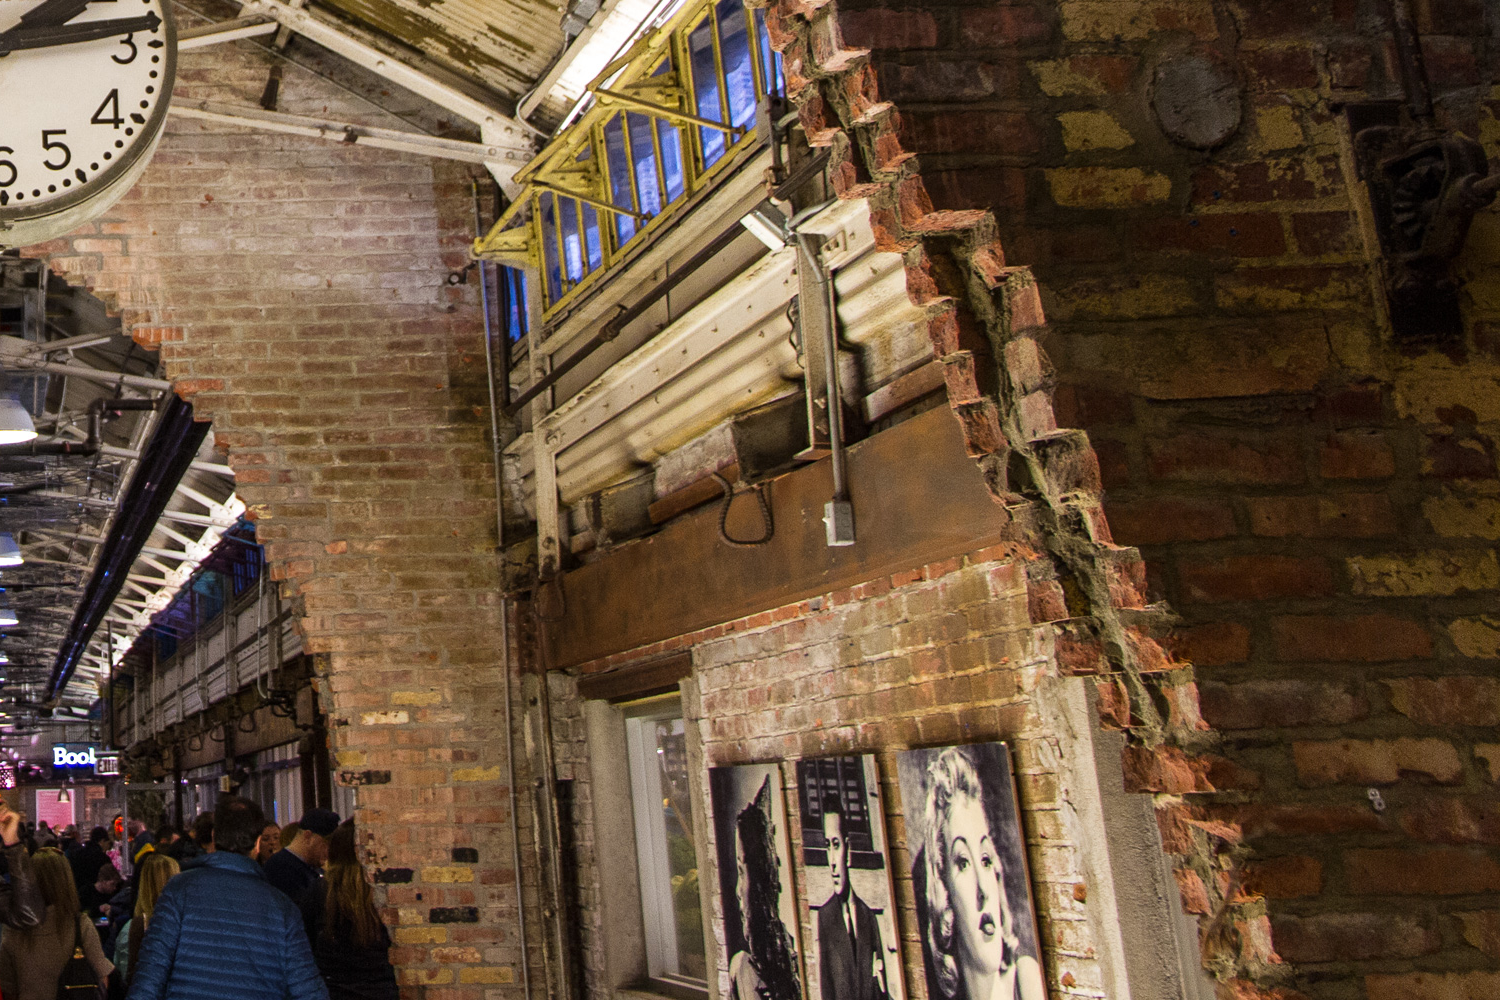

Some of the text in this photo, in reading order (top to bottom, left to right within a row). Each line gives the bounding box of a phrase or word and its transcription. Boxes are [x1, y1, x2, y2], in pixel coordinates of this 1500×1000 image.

[110, 32, 138, 65] 3
[90, 88, 125, 130] 4
[41, 129, 71, 171] 5
